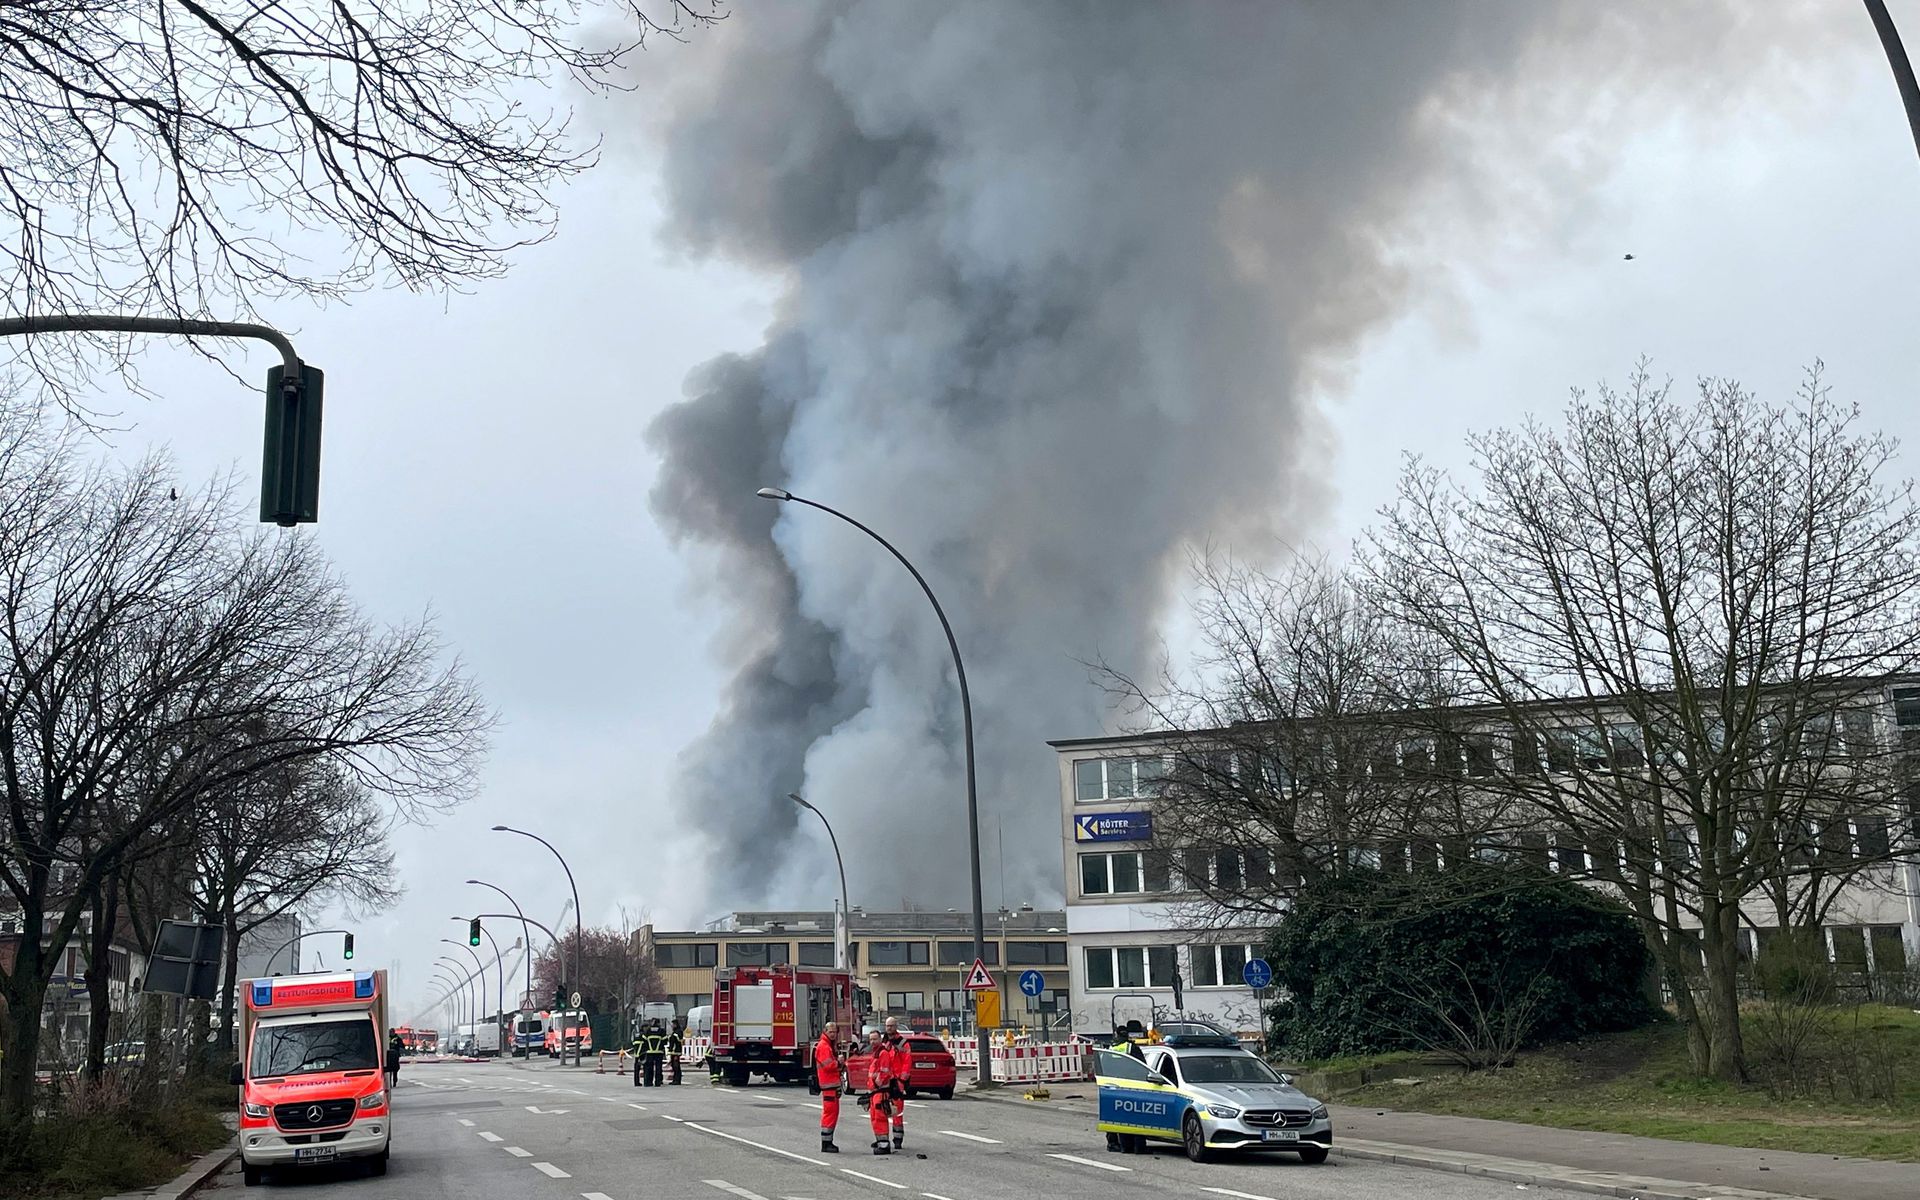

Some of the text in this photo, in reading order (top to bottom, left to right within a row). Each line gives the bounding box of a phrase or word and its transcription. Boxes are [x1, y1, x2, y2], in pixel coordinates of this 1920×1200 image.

[1100, 819, 1129, 828] KÖTTER
[277, 987, 350, 998] RETTUNGSDIENST
[782, 1012, 794, 1020] 112
[1114, 1099, 1166, 1115] POLIZEI
